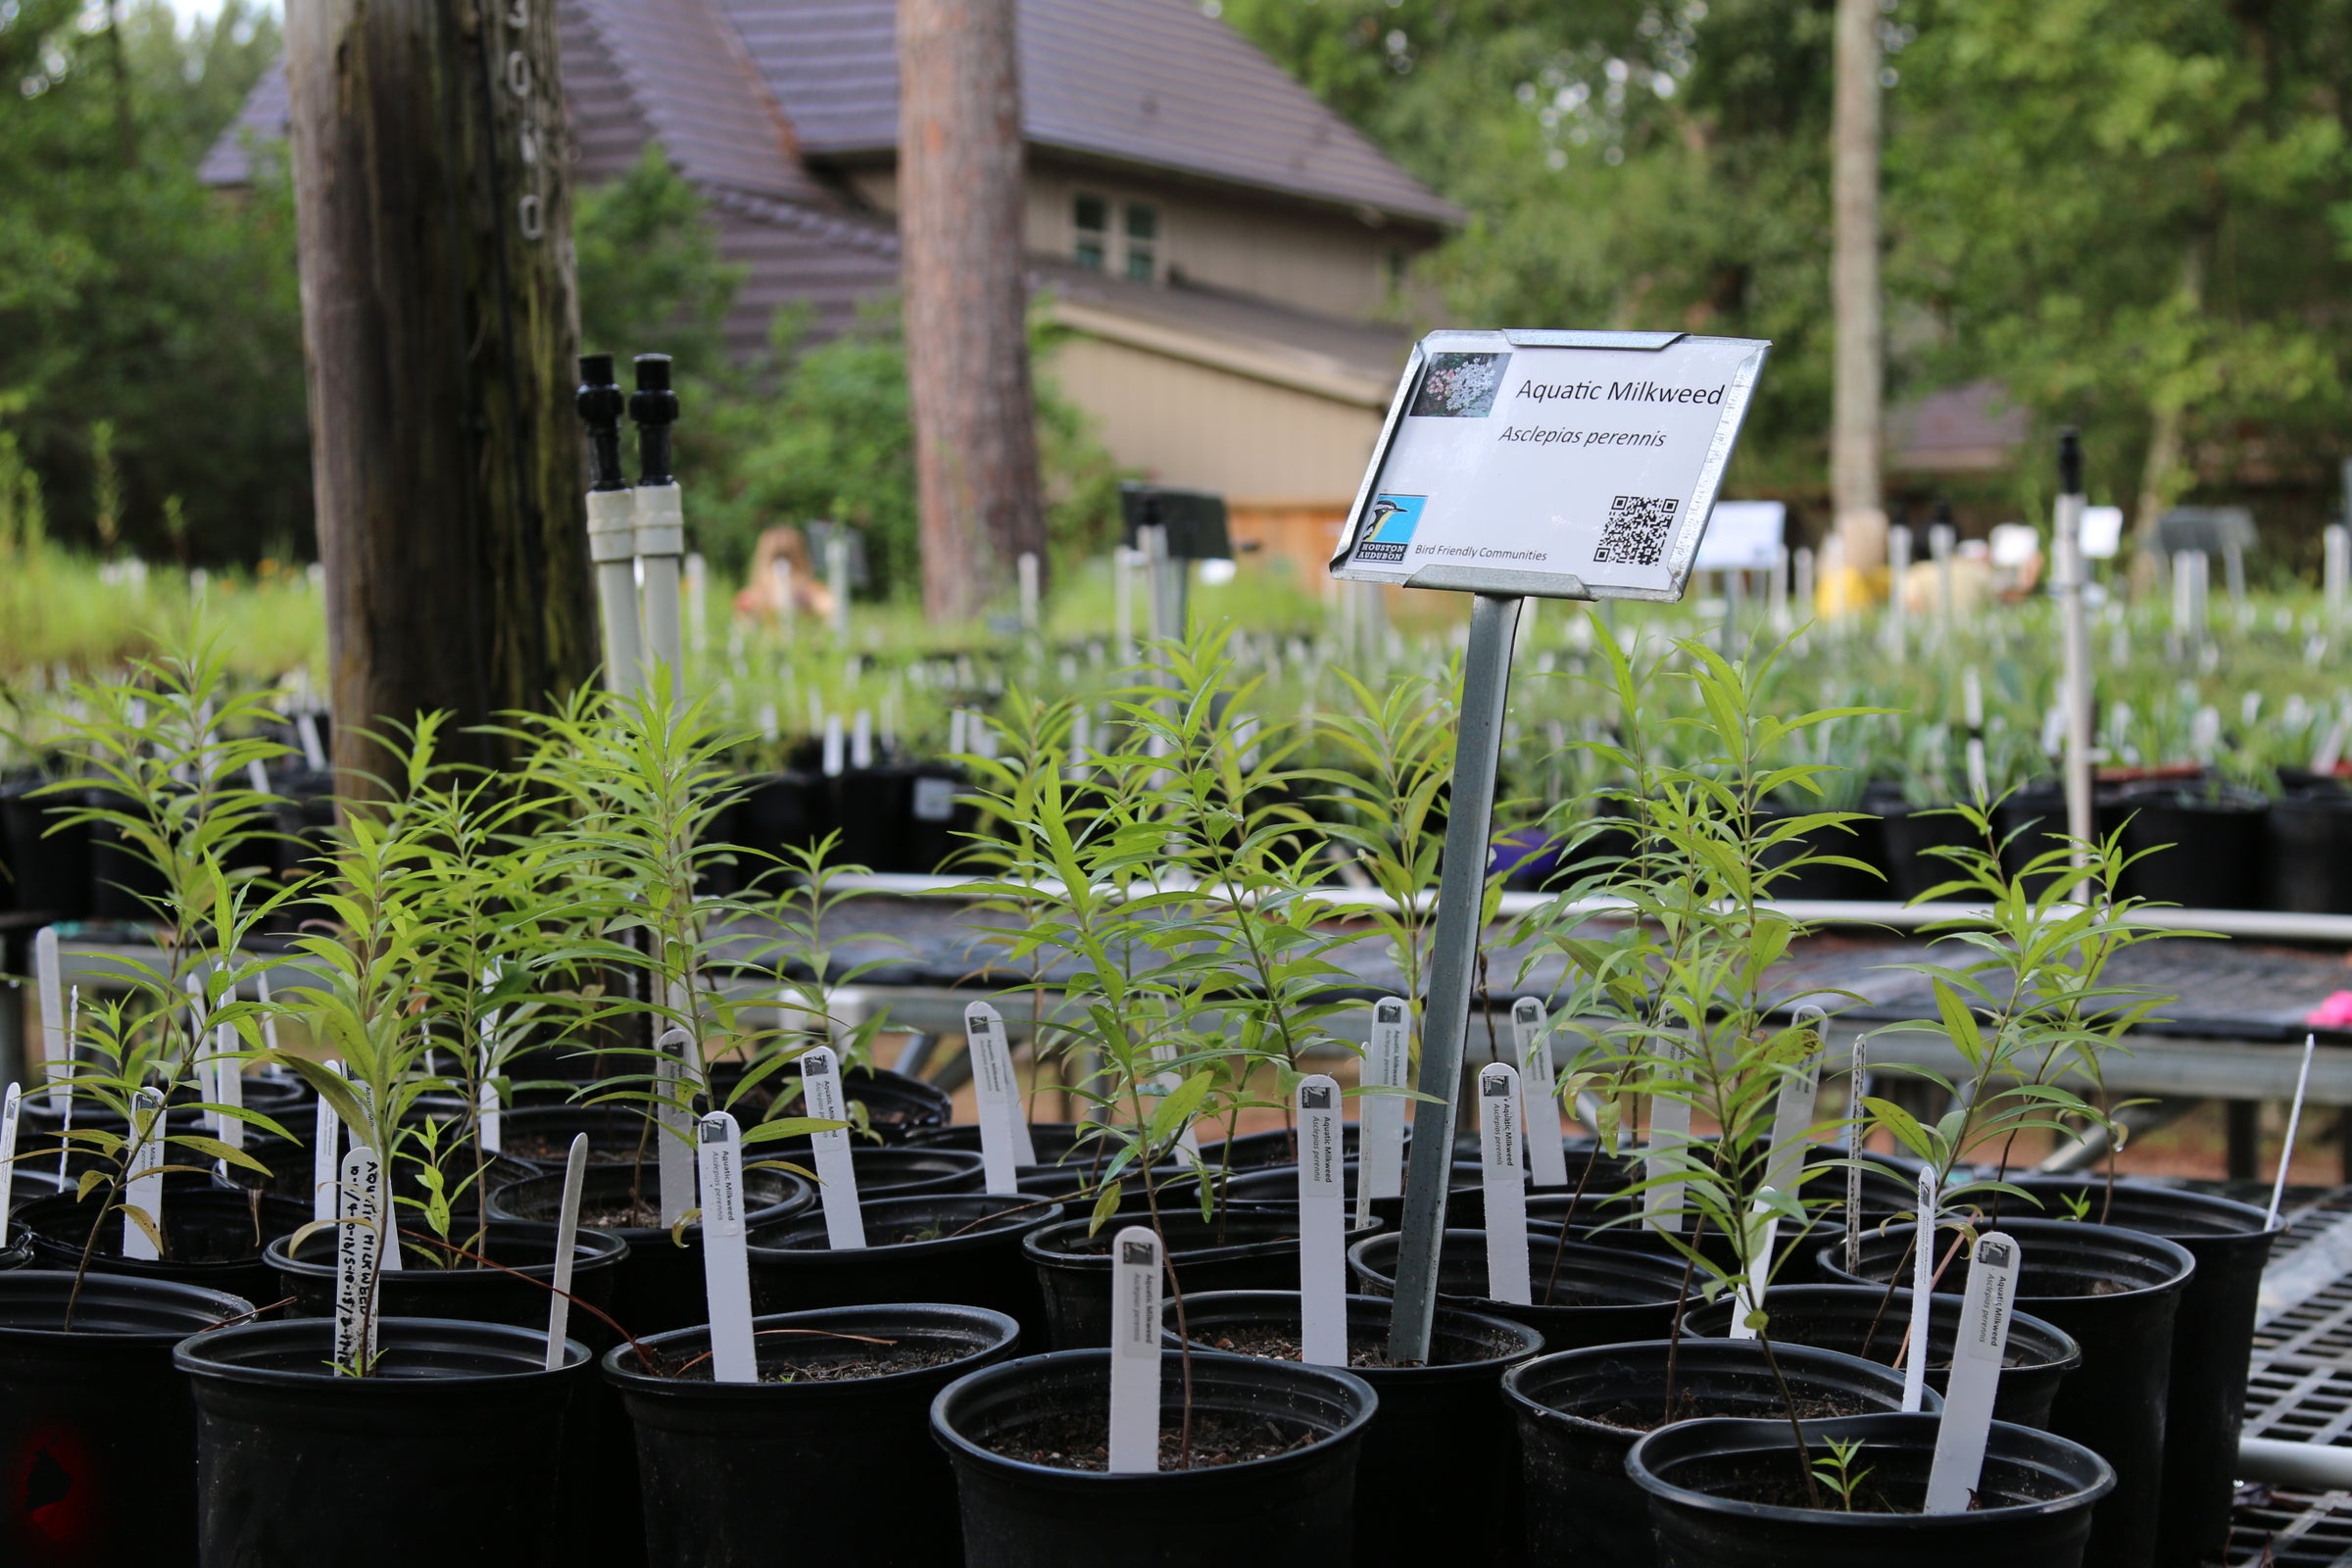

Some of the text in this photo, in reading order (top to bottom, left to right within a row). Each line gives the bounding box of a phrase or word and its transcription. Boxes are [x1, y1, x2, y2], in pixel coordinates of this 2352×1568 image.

[1516, 379, 1725, 406] Aquatic Milkweed
[1497, 425, 1668, 448] Asclepias perennis
[1357, 551, 1402, 562] AUDUBON
[1361, 543, 1405, 554] HOUSTON
[1415, 545, 1547, 562] Bird Friendly Communities
[1502, 1103, 1514, 1166] Aquatic Milkweed
[1312, 1152, 1321, 1182] perennis
[1324, 1146, 1333, 1183] Milkweed
[711, 1151, 723, 1221] Asclepias perennis
[721, 1151, 735, 1221] Aquatic Milkweed
[1983, 1273, 1995, 1309] Asclepias
[1145, 1274, 1154, 1345] Aquatic Milkweed
[1980, 1308, 1989, 1343] perennis
[1991, 1276, 2007, 1347] Aquatic Milkweed
